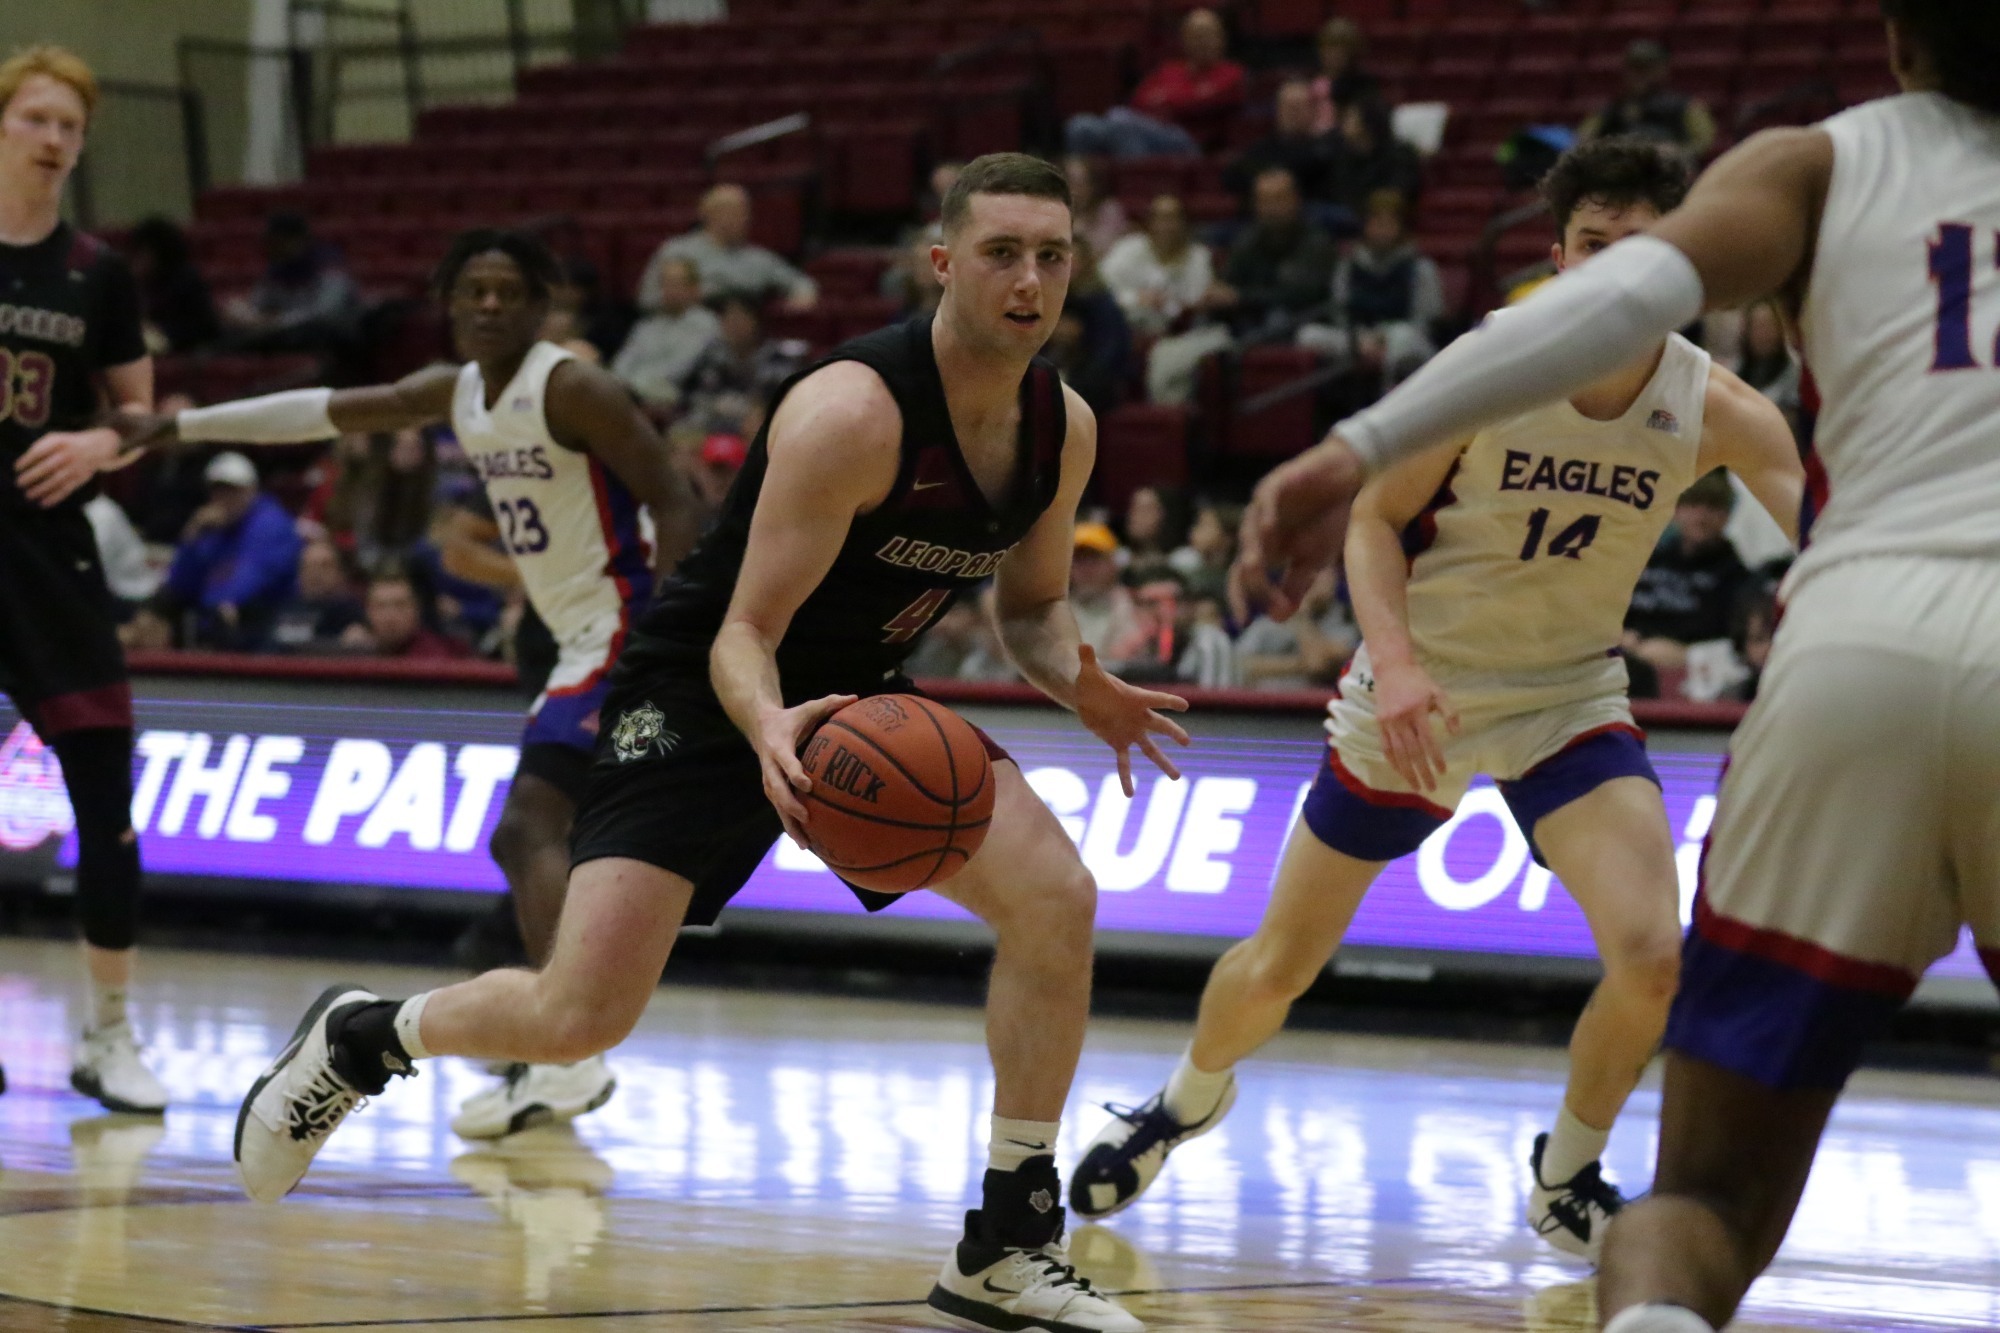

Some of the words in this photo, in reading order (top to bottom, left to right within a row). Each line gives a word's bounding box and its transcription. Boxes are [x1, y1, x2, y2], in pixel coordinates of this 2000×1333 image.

[1927, 222, 2000, 374] 1
[1499, 449, 1661, 510] EAGLES
[500, 497, 549, 555] 23
[1519, 506, 1602, 561] 14
[875, 536, 1019, 578] LEOPAR
[881, 588, 951, 643] 4
[130, 729, 306, 843] THE
[821, 743, 886, 804] ROCK
